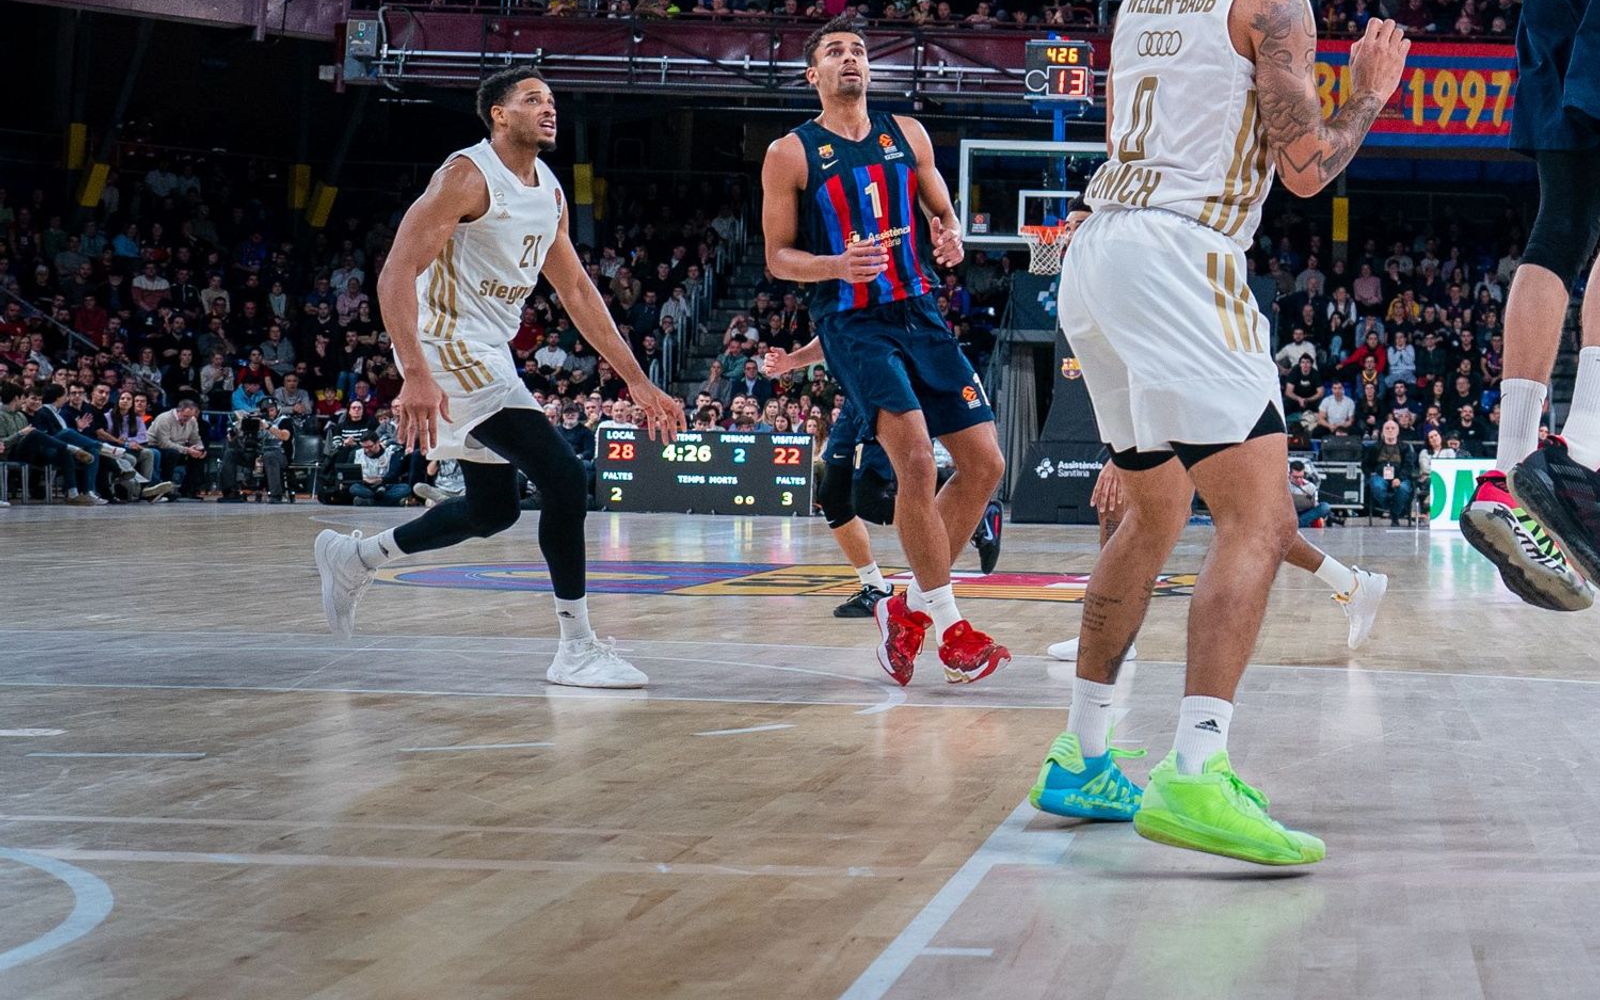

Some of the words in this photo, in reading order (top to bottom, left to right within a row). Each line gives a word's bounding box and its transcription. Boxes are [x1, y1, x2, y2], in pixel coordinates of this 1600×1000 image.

[1057, 68, 1084, 95] 13
[1408, 67, 1511, 129] 1997
[1118, 76, 1159, 164] 0
[864, 182, 883, 219] 1
[519, 234, 542, 268] 21
[607, 431, 635, 440] LOCAL
[772, 436, 810, 445] VISITANT
[608, 443, 634, 460] 28
[662, 444, 712, 461] 4:26
[734, 448, 746, 463] 2
[774, 448, 800, 464] 22
[603, 472, 632, 480] FALTES
[678, 476, 705, 484] TEMPS
[776, 476, 806, 486] FALTES
[610, 488, 622, 501] 2
[782, 492, 793, 506] 3
